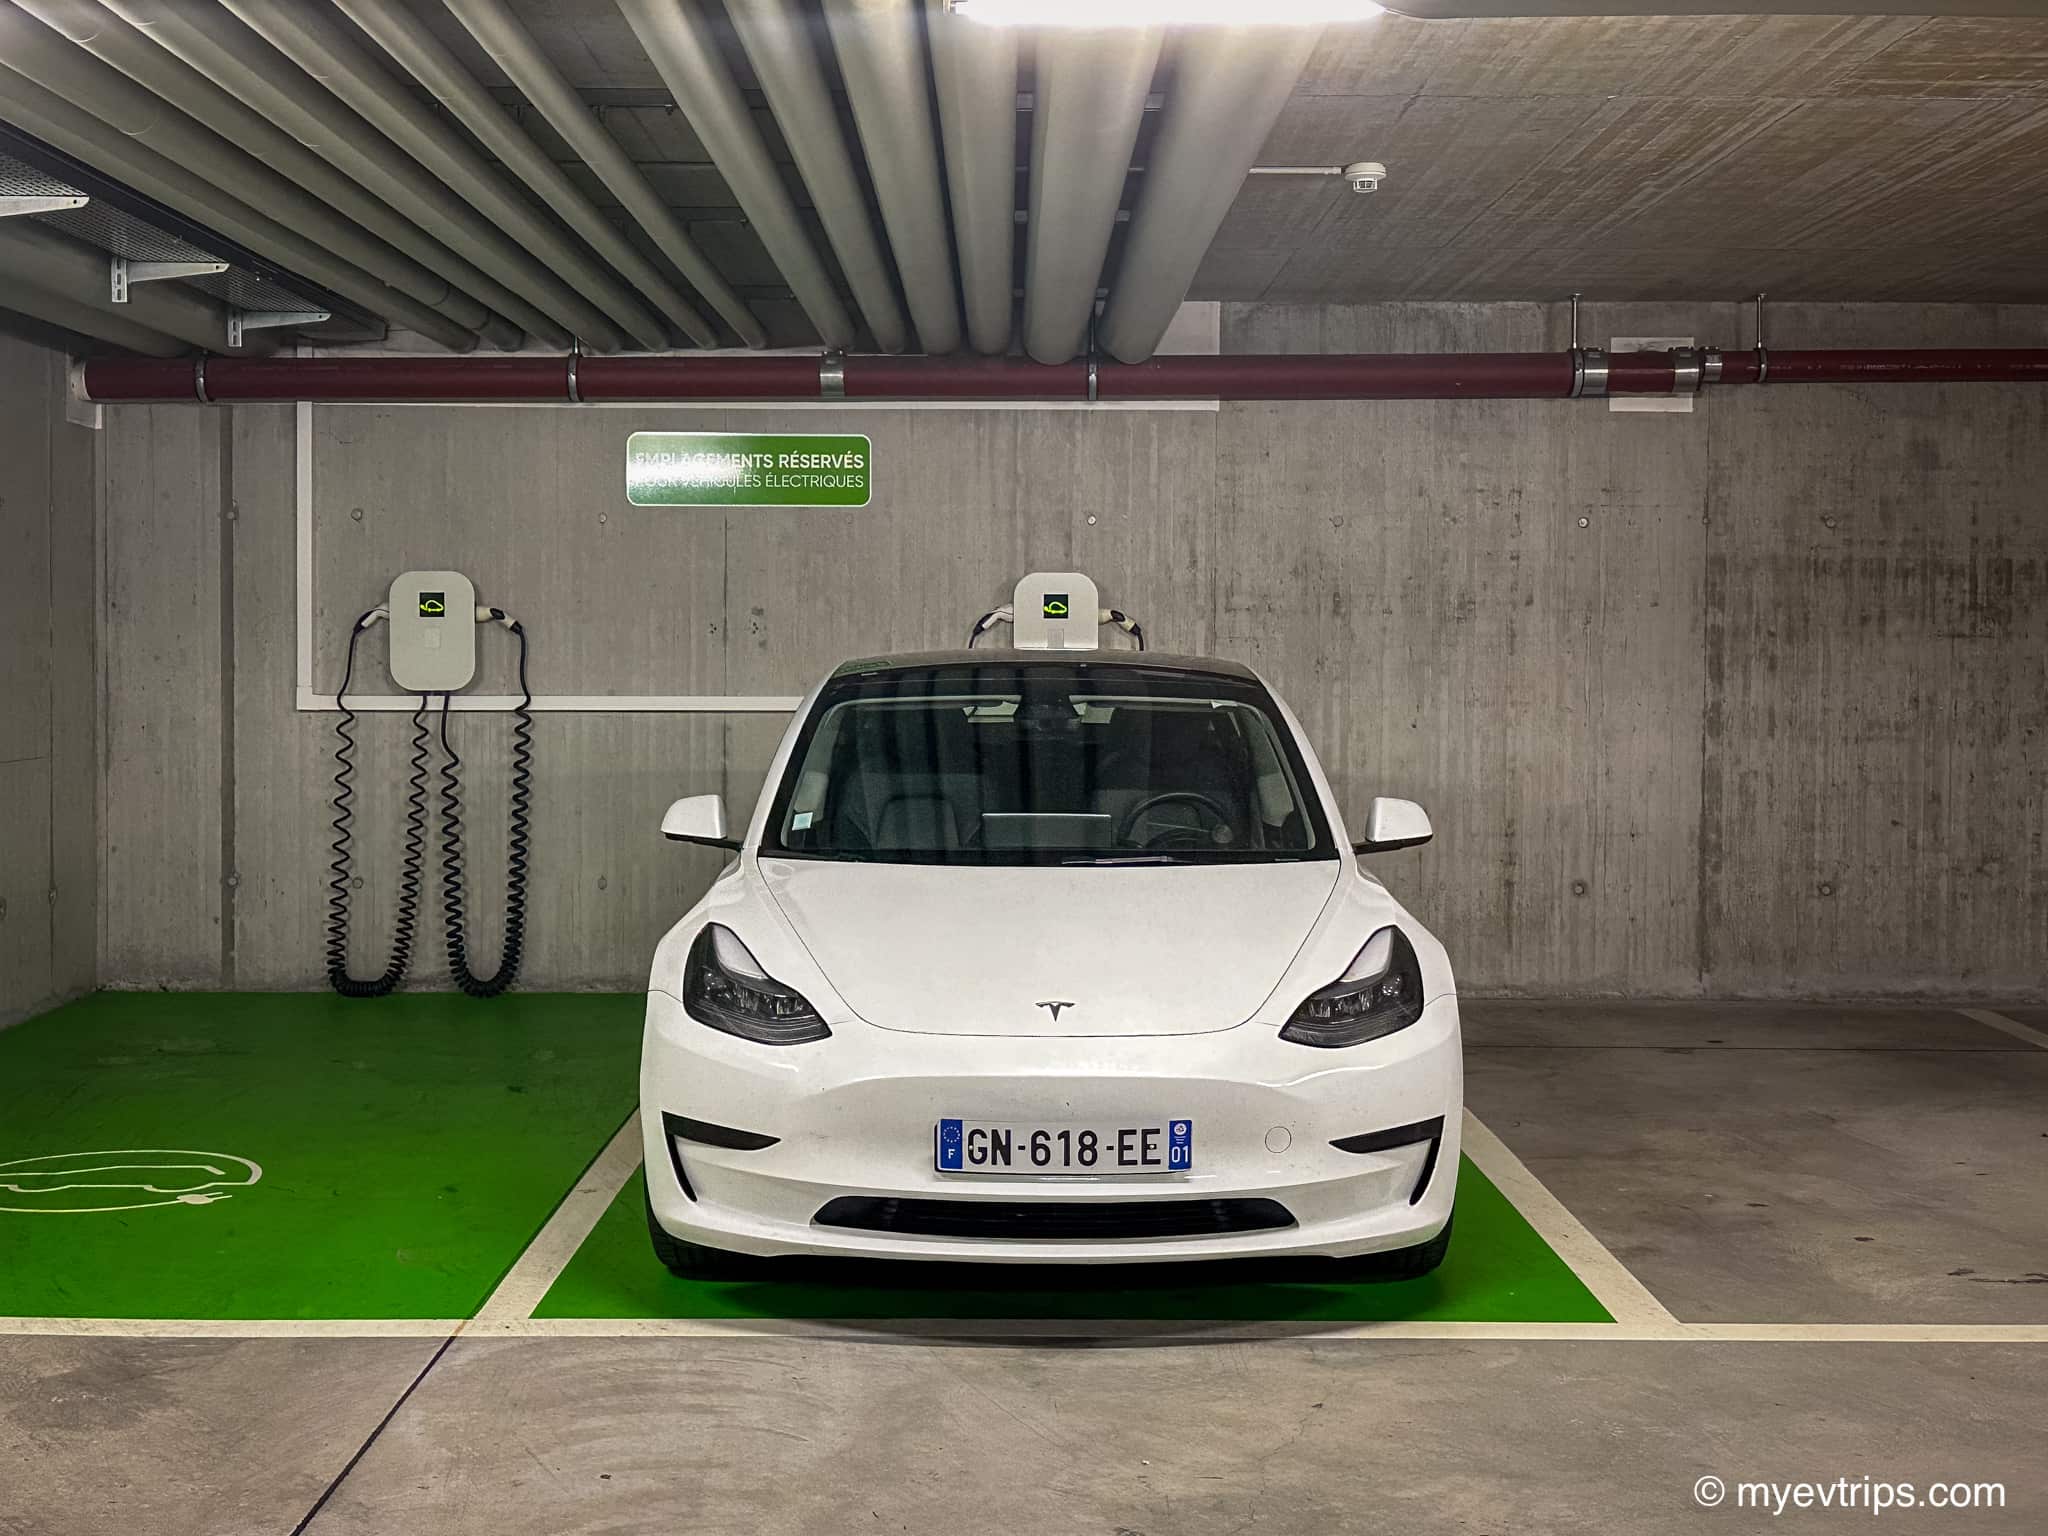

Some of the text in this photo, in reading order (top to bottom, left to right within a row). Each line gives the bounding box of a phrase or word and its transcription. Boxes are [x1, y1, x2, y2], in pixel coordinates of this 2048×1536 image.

[778, 450, 865, 468] RÉSERVÉS
[765, 472, 864, 488] ÉLECTRIQUES
[947, 1148, 955, 1160] F
[967, 1128, 1161, 1167] GN-618-EE
[1171, 1144, 1189, 1163] 01
